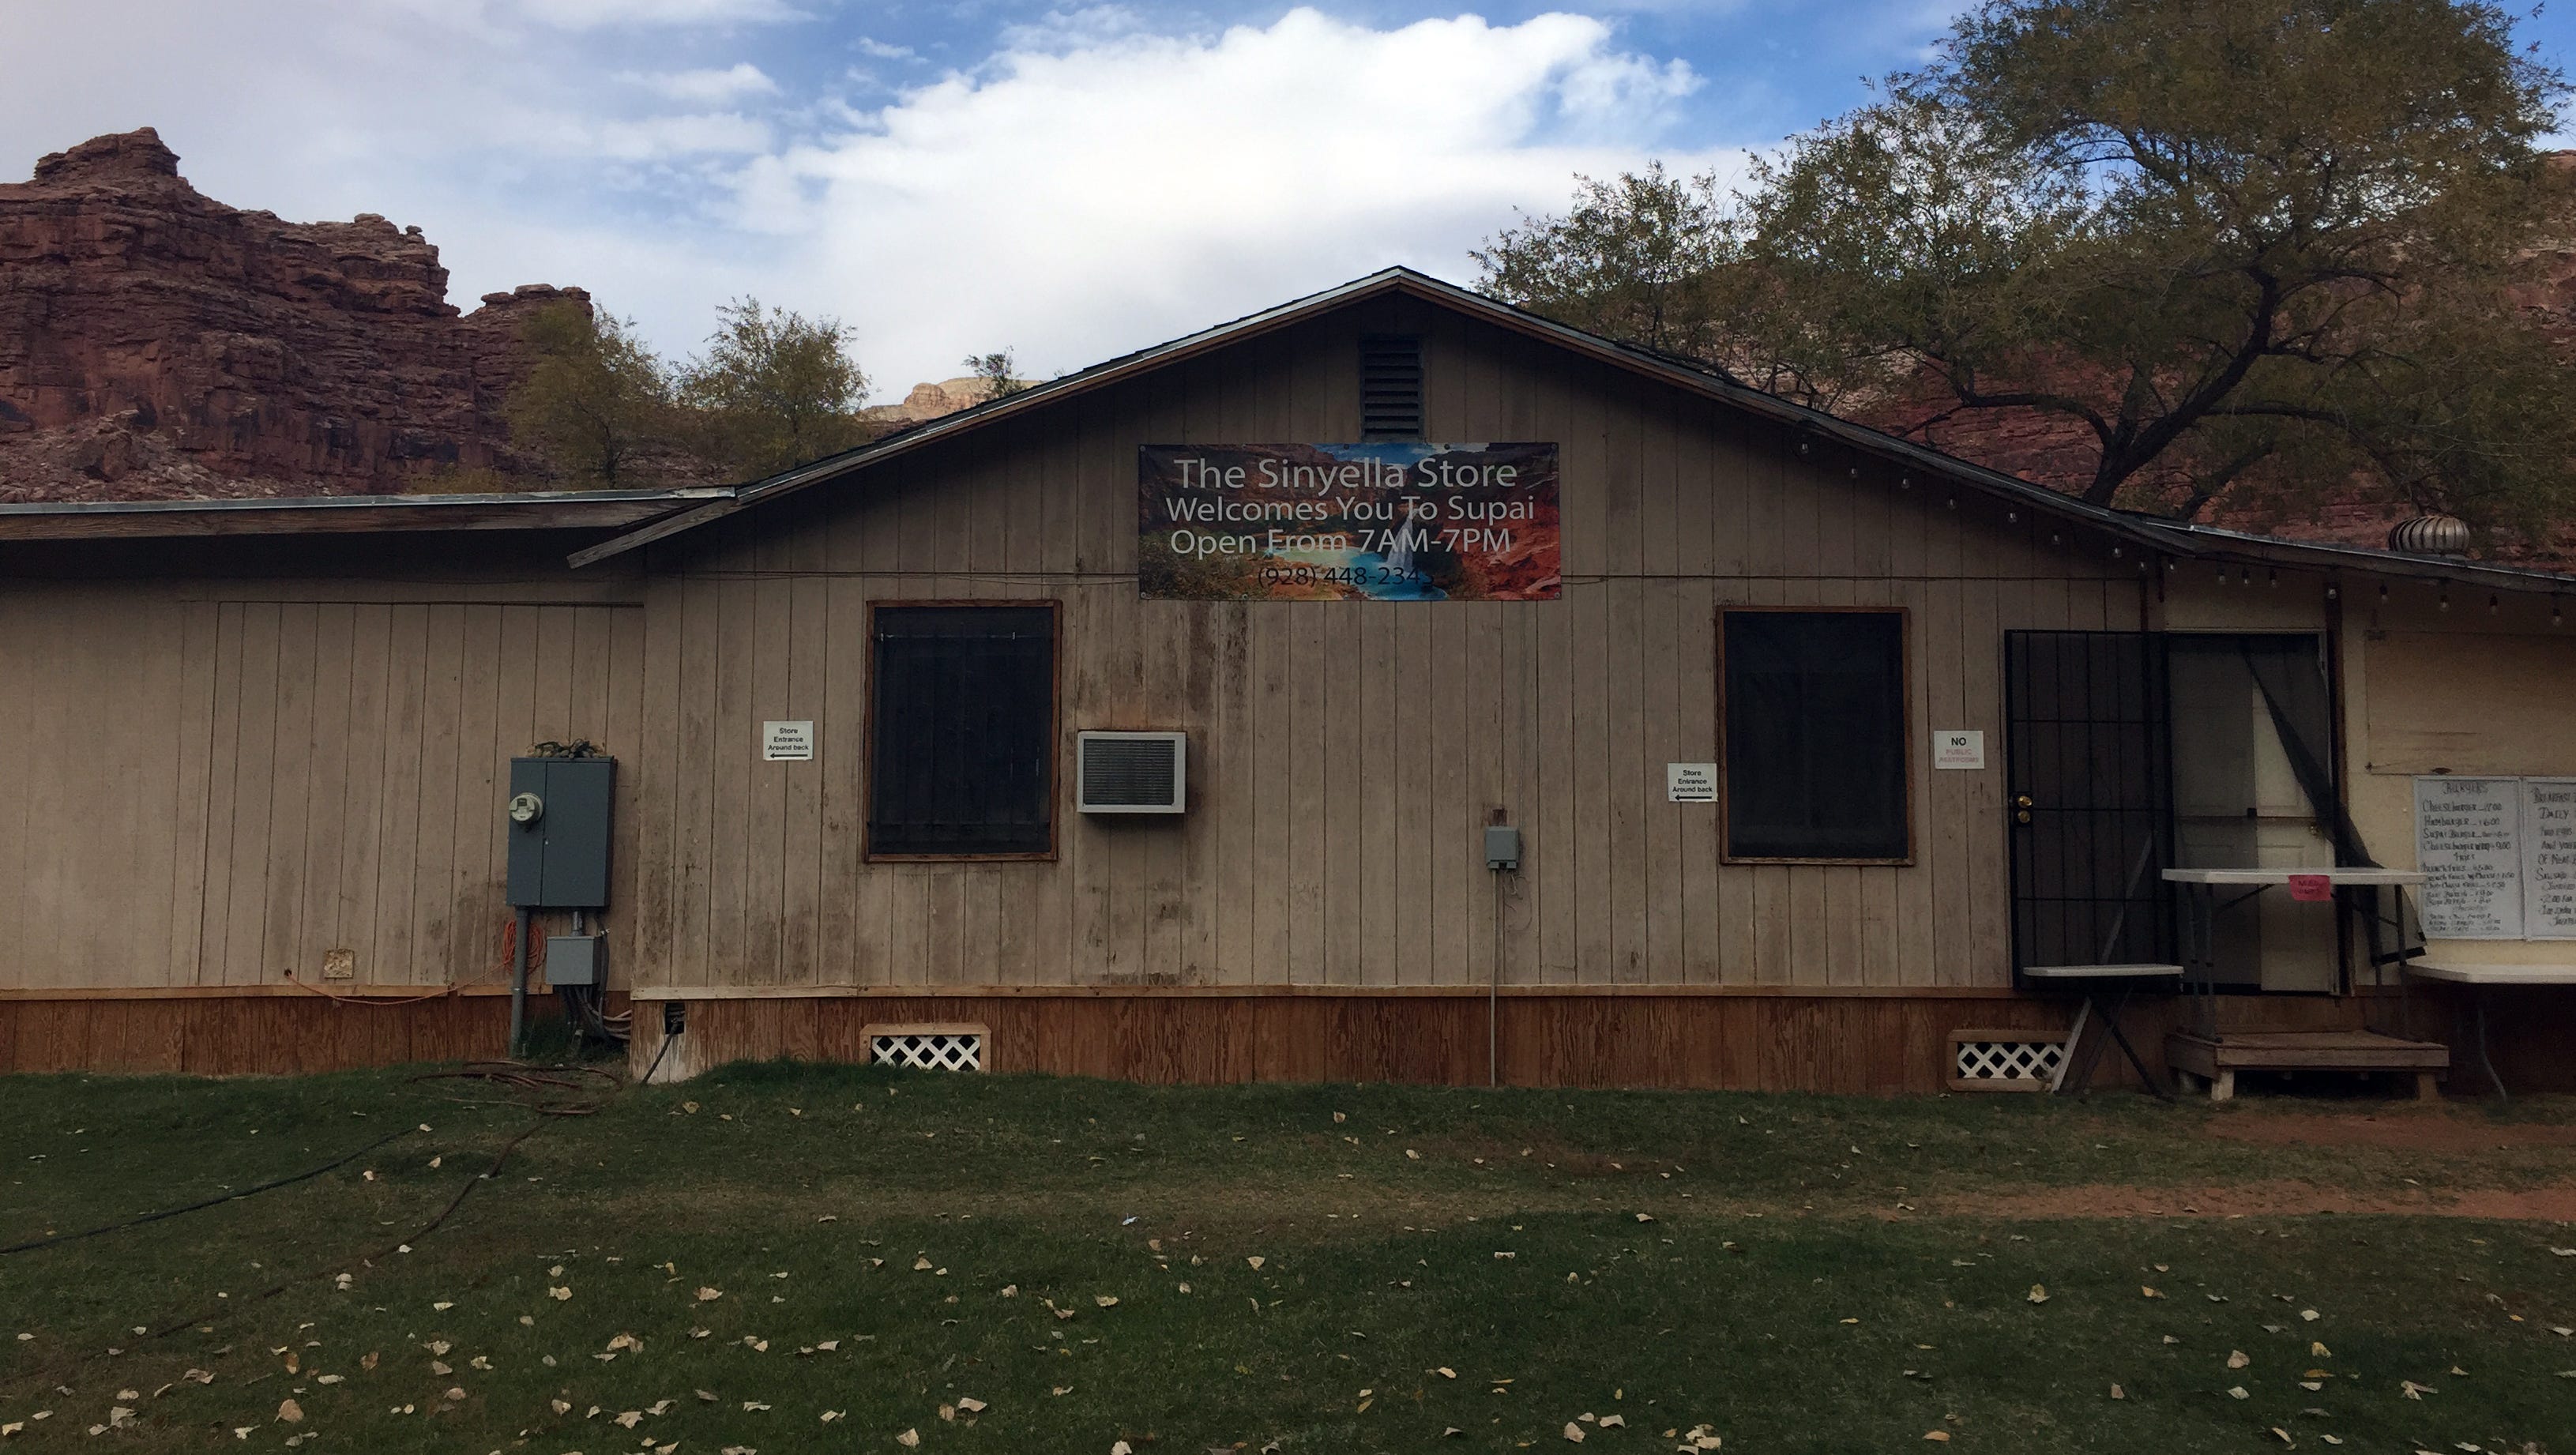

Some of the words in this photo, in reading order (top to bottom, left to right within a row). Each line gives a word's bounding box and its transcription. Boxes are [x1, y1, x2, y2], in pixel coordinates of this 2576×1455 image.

[1174, 458, 1246, 488] The
[1258, 457, 1405, 497] Sinyella
[1418, 458, 1517, 488] Store
[1166, 496, 1327, 521] Welcomes
[1337, 496, 1393, 521] You
[1401, 496, 1438, 521] To
[1448, 494, 1534, 526] Supai
[1170, 528, 1256, 559] Open
[1269, 528, 1347, 553] From
[1359, 528, 1510, 553] 7AM-7PM
[1258, 566, 1316, 588] (928)
[1951, 737, 1967, 746] NO
